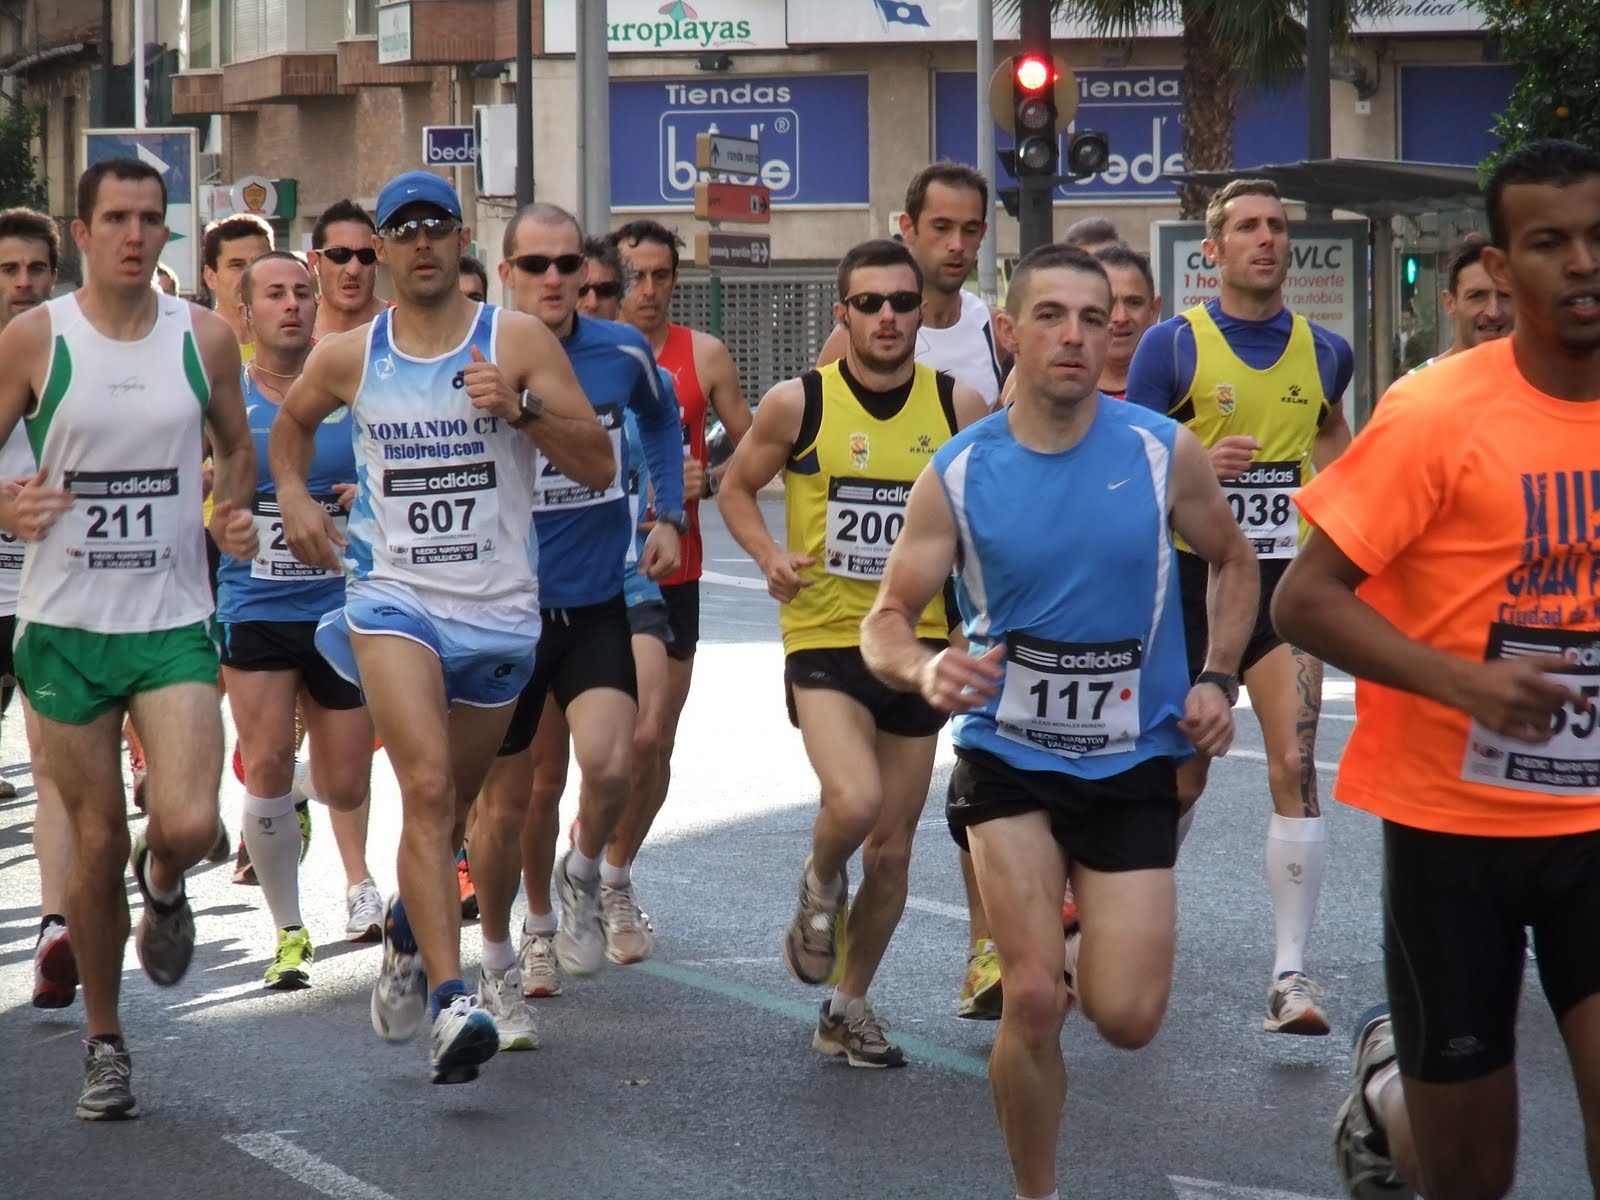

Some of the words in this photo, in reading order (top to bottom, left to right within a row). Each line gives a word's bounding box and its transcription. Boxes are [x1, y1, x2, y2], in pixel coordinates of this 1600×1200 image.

[607, 20, 751, 47] uroplayas
[665, 83, 791, 105] Tiendas
[1074, 76, 1179, 97] ienda
[1184, 273, 1190, 288] 1
[1196, 273, 1220, 289] ho
[1280, 396, 1309, 405] KELME
[367, 418, 468, 441] KOMANDO
[473, 416, 499, 435] CT
[109, 476, 172, 494] adidas
[428, 471, 489, 490] adidas
[1238, 468, 1294, 484] adidas
[86, 503, 152, 538] 211
[407, 497, 476, 535] 607
[1060, 651, 1133, 669] adidas
[1030, 679, 1114, 720] 117
